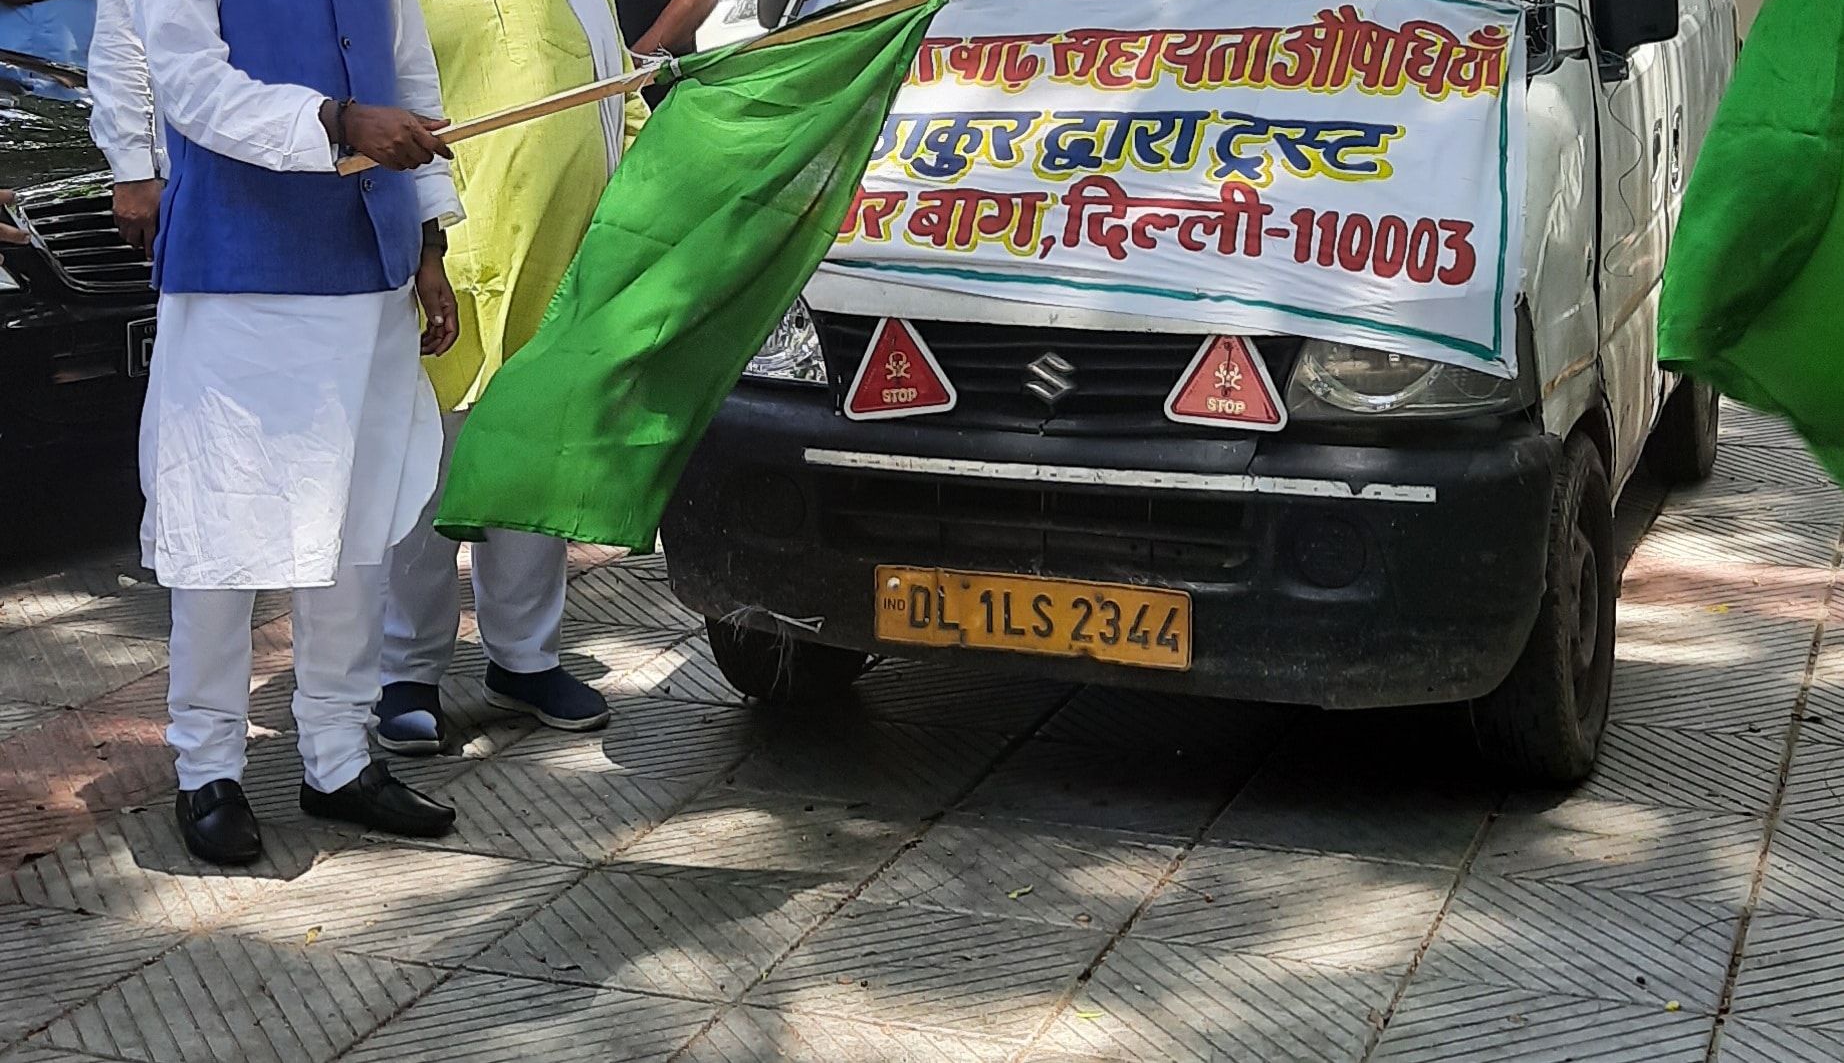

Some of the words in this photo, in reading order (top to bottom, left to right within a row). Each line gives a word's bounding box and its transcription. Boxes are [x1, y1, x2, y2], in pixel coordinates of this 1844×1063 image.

[1050, 26, 1285, 91] सहायता
[1032, 111, 1214, 180] द्वारा
[1207, 111, 1406, 187] ट्रस्ट
[881, 387, 918, 403] STOP
[1206, 397, 1246, 415] STOP
[883, 597, 906, 611] IND
[909, 585, 960, 630] DL
[980, 589, 1055, 638] 1LS
[1070, 597, 1180, 653] 2344
